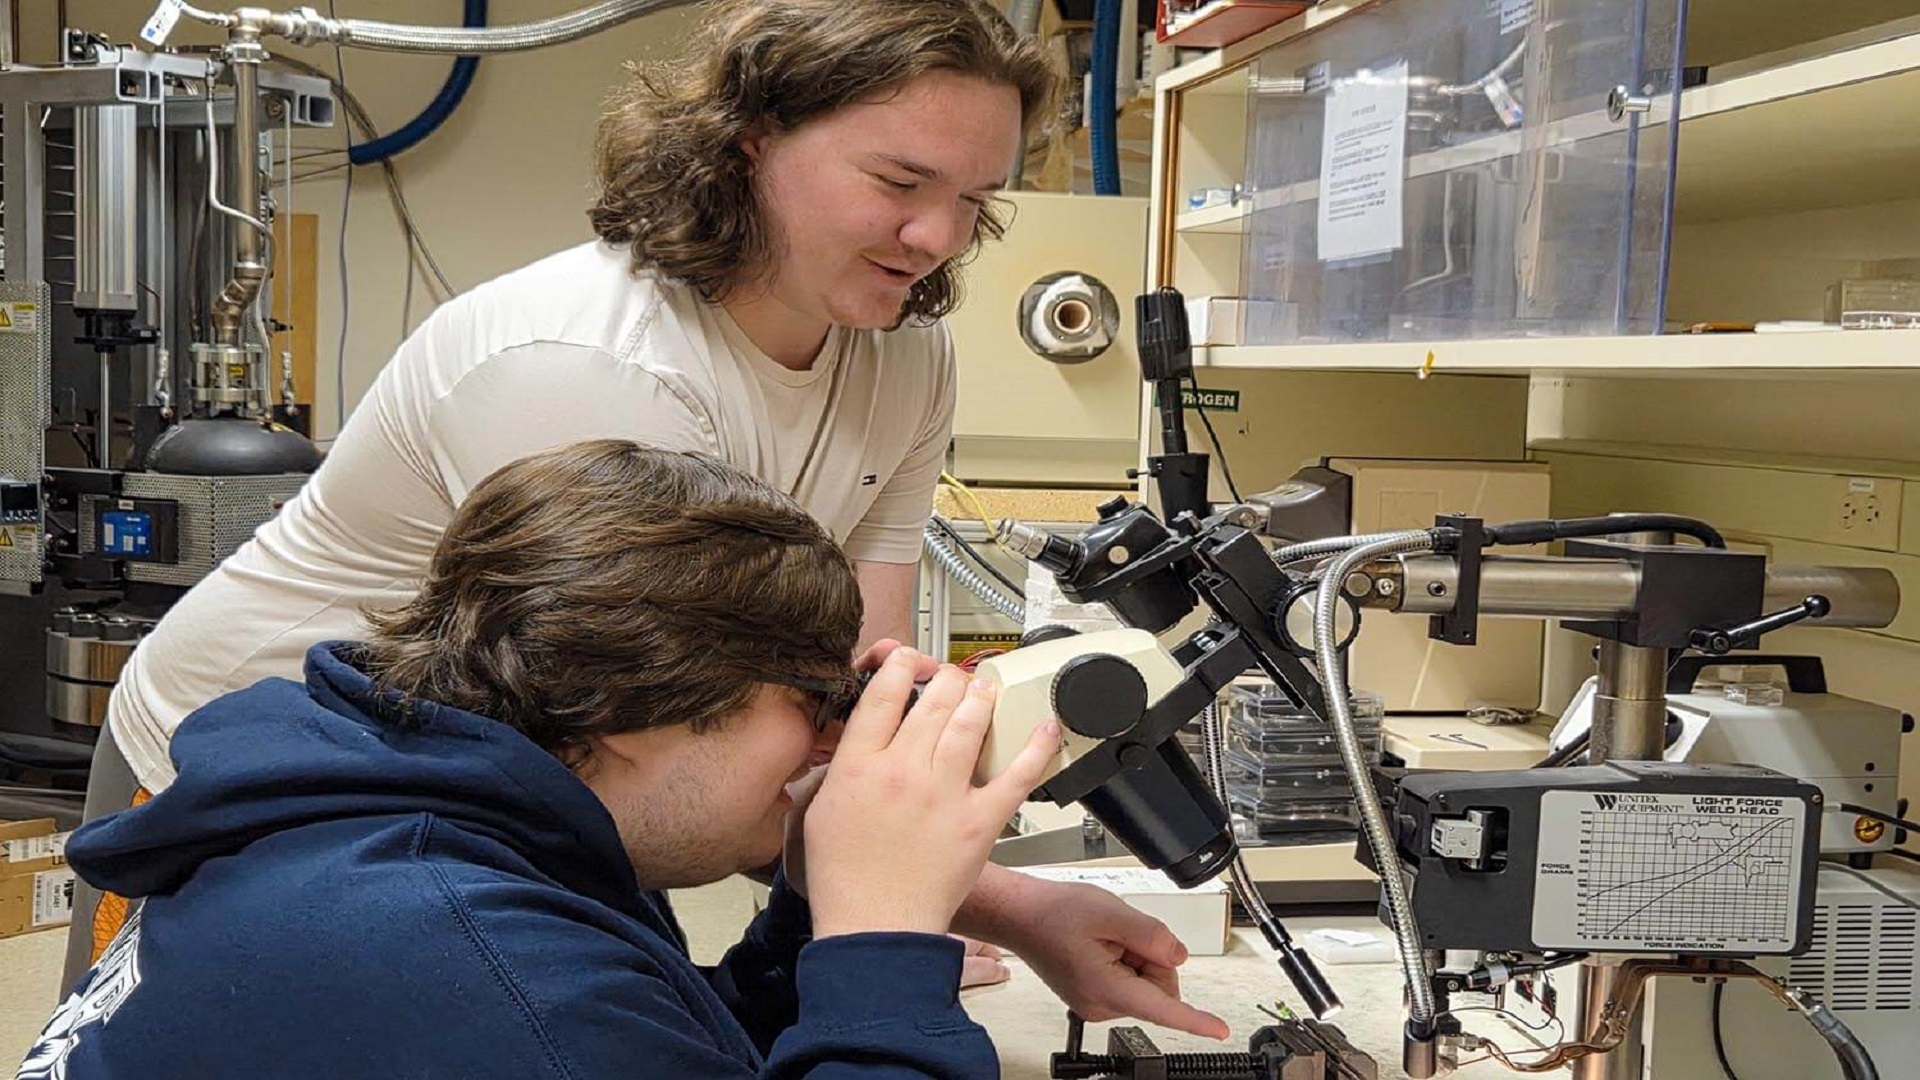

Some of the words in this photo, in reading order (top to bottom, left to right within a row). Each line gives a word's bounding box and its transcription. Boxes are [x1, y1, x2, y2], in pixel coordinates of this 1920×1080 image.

[1692, 796, 1733, 805] LIGHT
[1736, 797, 1783, 807] FORCE
[1618, 804, 1681, 814] EQUIPMENT
[1695, 805, 1735, 814] WELD
[1740, 806, 1779, 815] HEAD
[1644, 941, 1673, 949] FORCE
